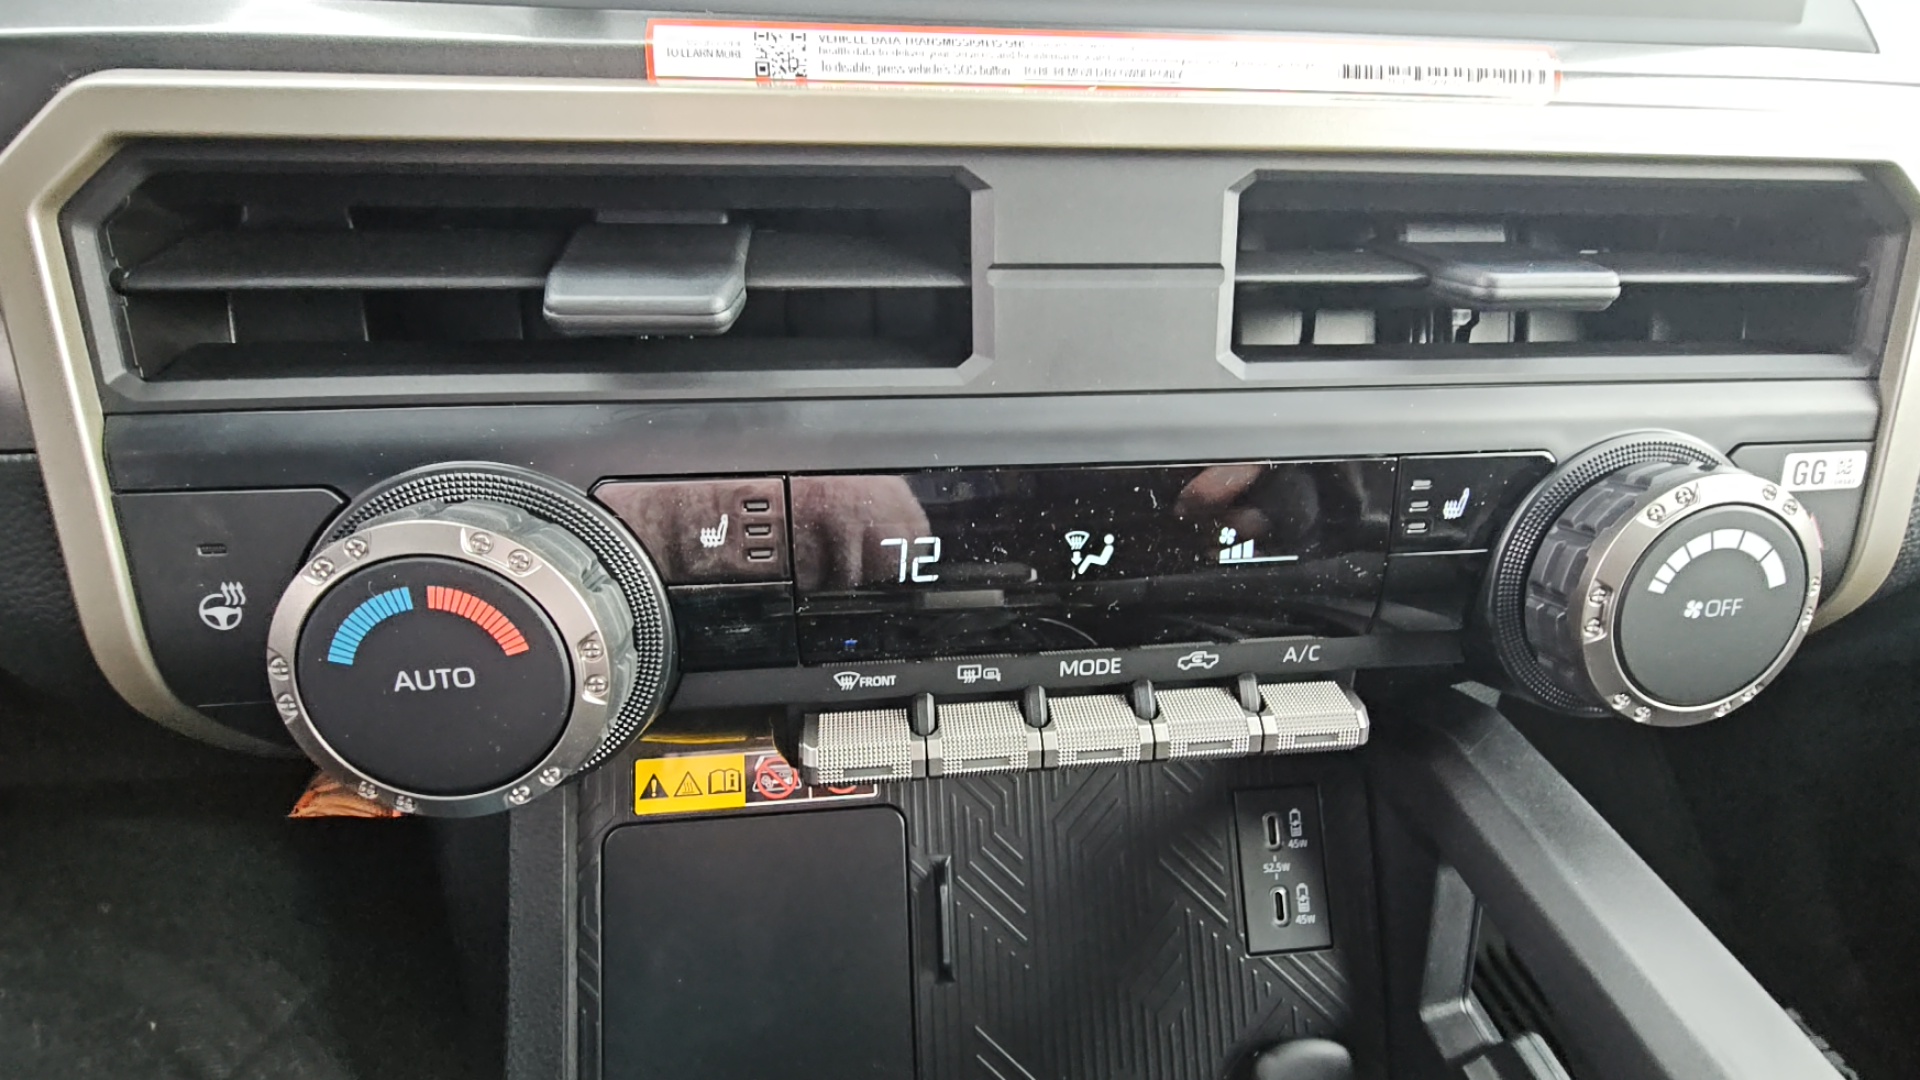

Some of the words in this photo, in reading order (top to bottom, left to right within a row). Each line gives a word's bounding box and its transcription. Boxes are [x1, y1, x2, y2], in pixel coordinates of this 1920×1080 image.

[1792, 459, 1828, 486] GG
[880, 536, 941, 583] 72
[1705, 598, 1744, 618] OFF
[1282, 644, 1321, 663] A/C
[1059, 657, 1122, 678] MODE
[394, 667, 476, 692] AUTO
[859, 675, 896, 688] FRONT
[1288, 838, 1309, 849] 45W
[1262, 862, 1291, 874] 52.5W
[1295, 914, 1316, 925] 45W
